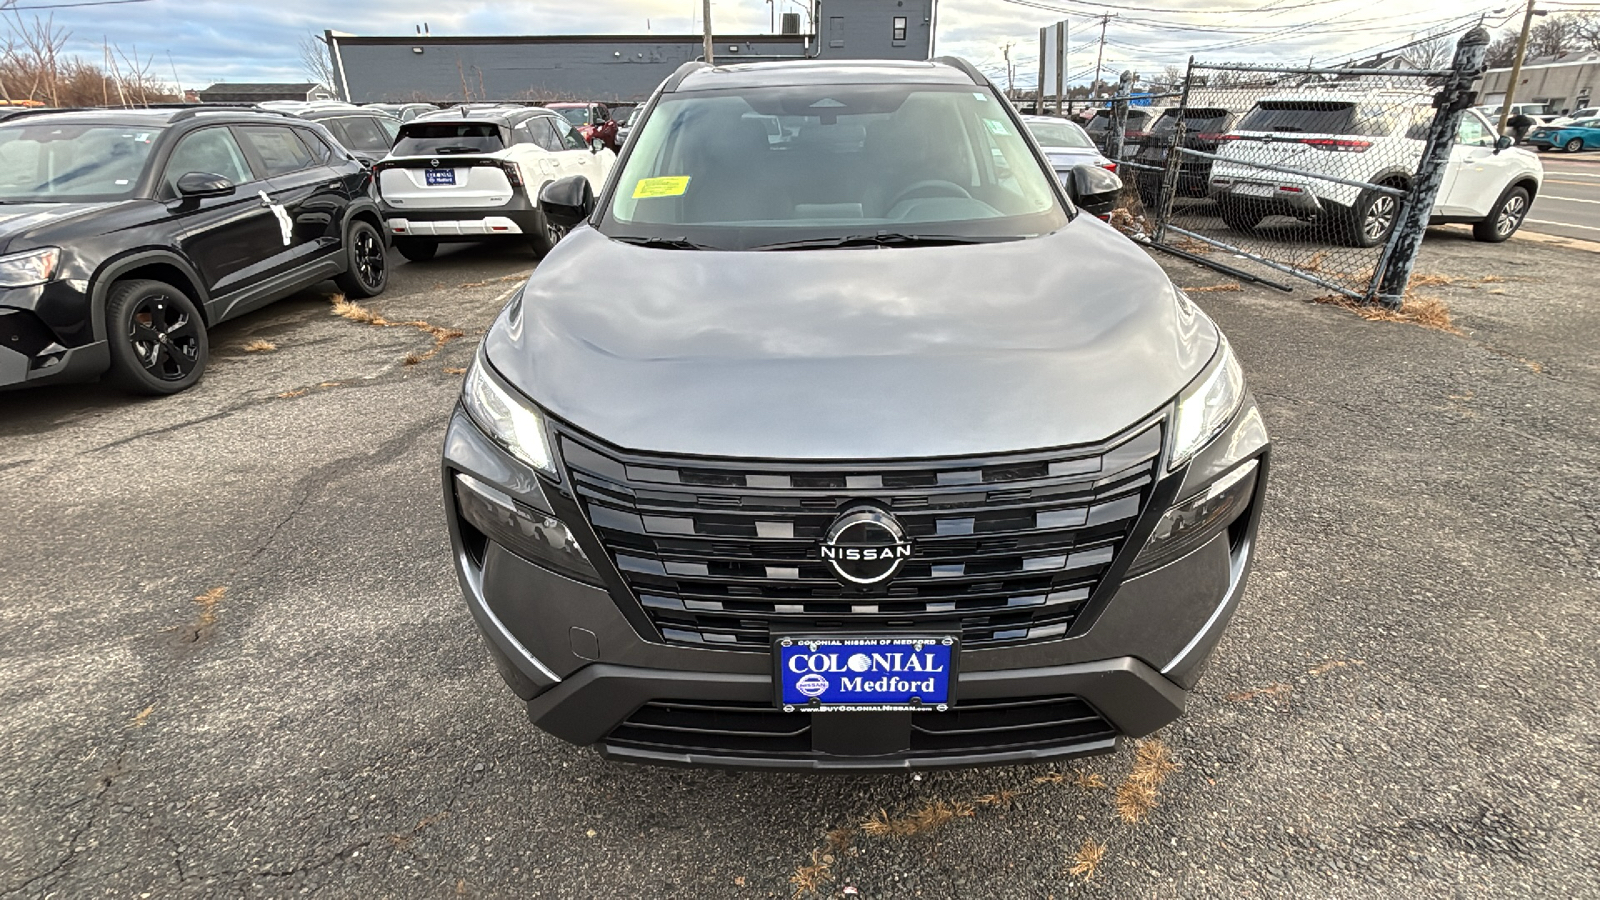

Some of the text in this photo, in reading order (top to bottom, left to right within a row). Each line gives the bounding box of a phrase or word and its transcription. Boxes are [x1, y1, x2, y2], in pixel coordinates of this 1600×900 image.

[821, 545, 911, 560] NISSAN
[788, 653, 943, 673] COLONIAL
[840, 676, 935, 692] Medford
